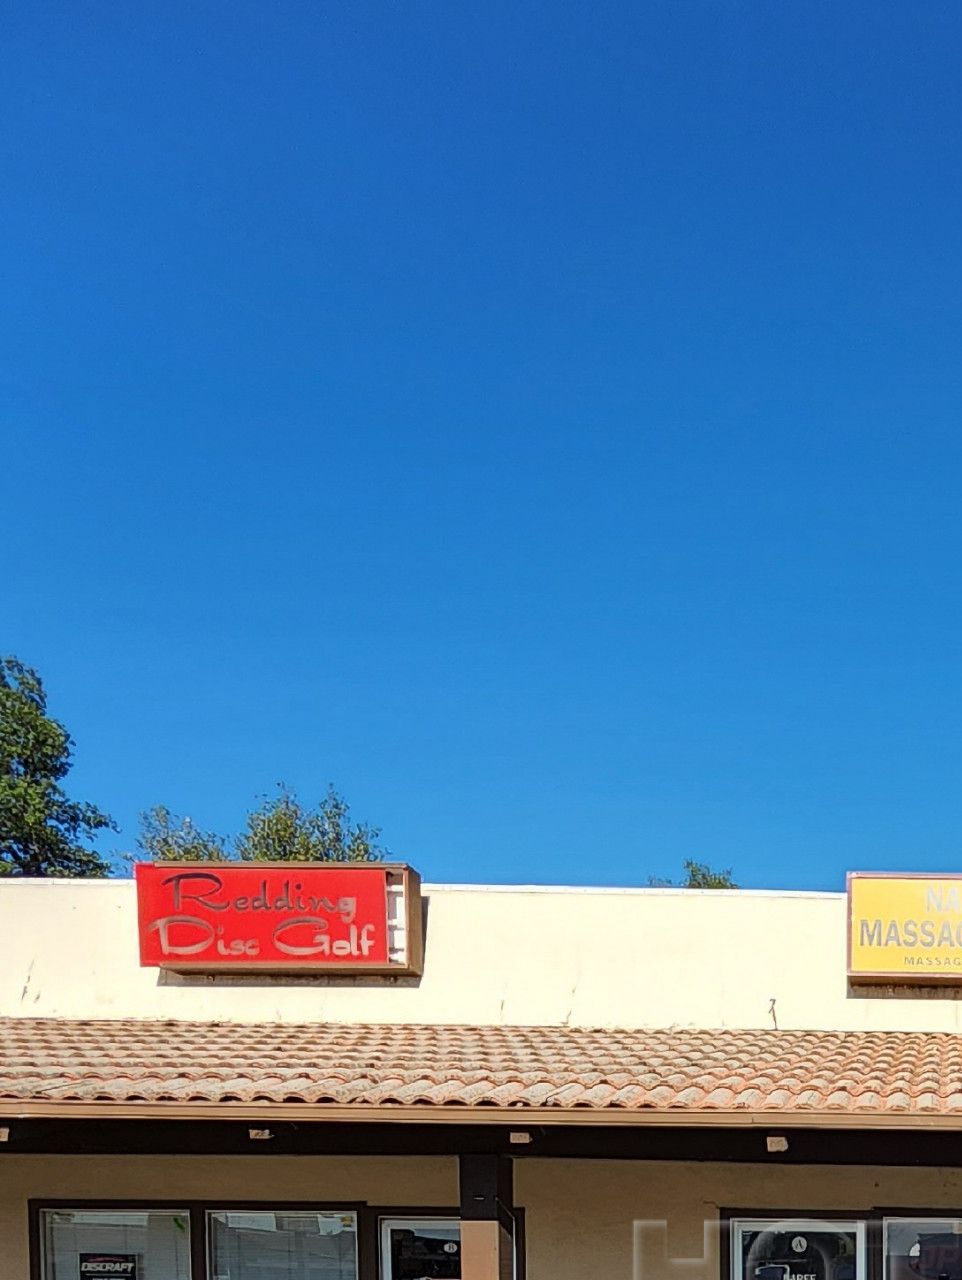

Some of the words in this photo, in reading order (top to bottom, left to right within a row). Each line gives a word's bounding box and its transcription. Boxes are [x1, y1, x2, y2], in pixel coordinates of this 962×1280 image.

[161, 872, 357, 923] Redding
[149, 914, 260, 956] Disc
[273, 917, 375, 956] Golf
